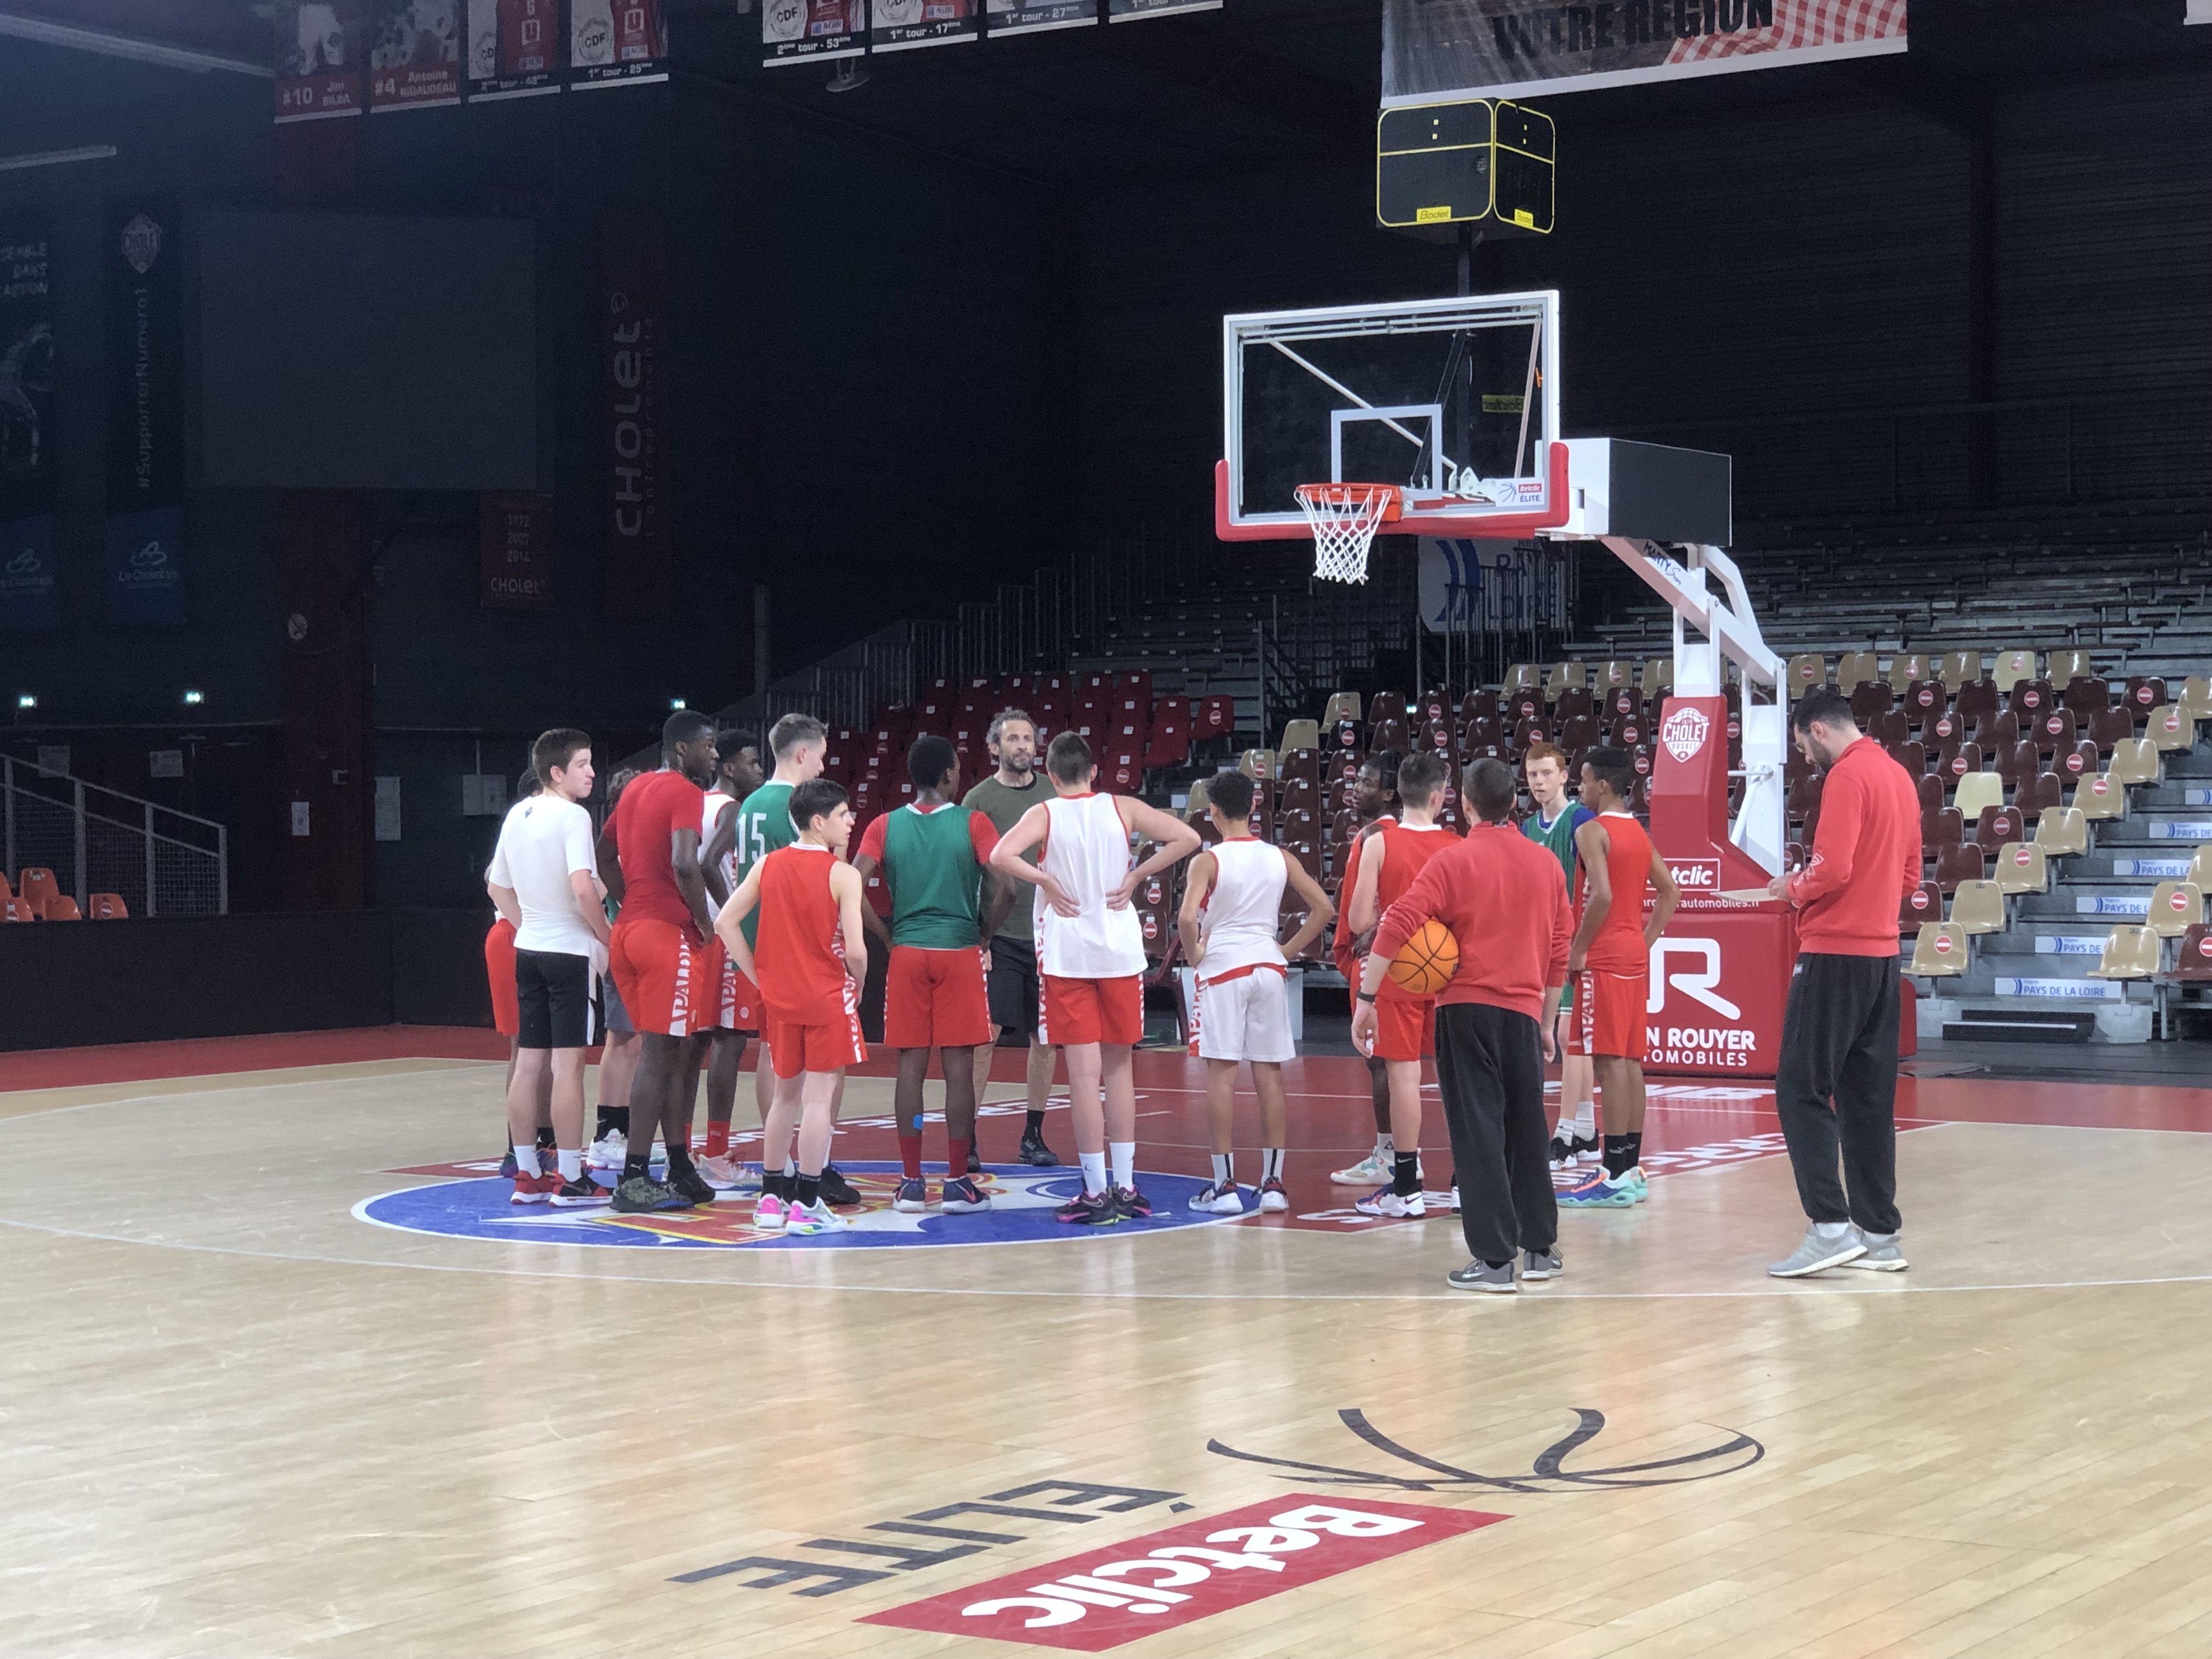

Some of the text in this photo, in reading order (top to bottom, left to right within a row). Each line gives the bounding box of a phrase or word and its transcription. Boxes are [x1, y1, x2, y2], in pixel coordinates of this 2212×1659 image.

[776, 7, 798, 22] CDF
[1022, 13, 1043, 22] tour
[906, 29, 927, 38] tour
[585, 33, 605, 48] CDF
[798, 42, 817, 52] tour
[408, 70, 448, 83] Antoine
[602, 67, 622, 77] tour
[326, 81, 345, 94] Jim
[374, 78, 457, 98] #4 RIGAUDEAU
[283, 87, 313, 107] #10
[1420, 209, 1449, 220] Bodet
[1520, 494, 1541, 503] ÉLITE
[507, 532, 529, 545] 2007
[507, 550, 531, 562] 2014
[1663, 723, 1710, 742] CHOLET
[738, 812, 767, 865] 15
[2176, 829, 2198, 838] PAYS
[2142, 866, 2163, 874] PAYS
[2105, 904, 2127, 912] PAYS
[2130, 905, 2141, 913] DE
[2064, 943, 2101, 952] PAYS DE
[2024, 986, 2106, 997] PAYS DE LA LOIRE
[1668, 1028, 1757, 1051] ROUYER
[664, 1479, 1195, 1598] ÉLITE
[961, 1502, 1427, 1629] Betclic
